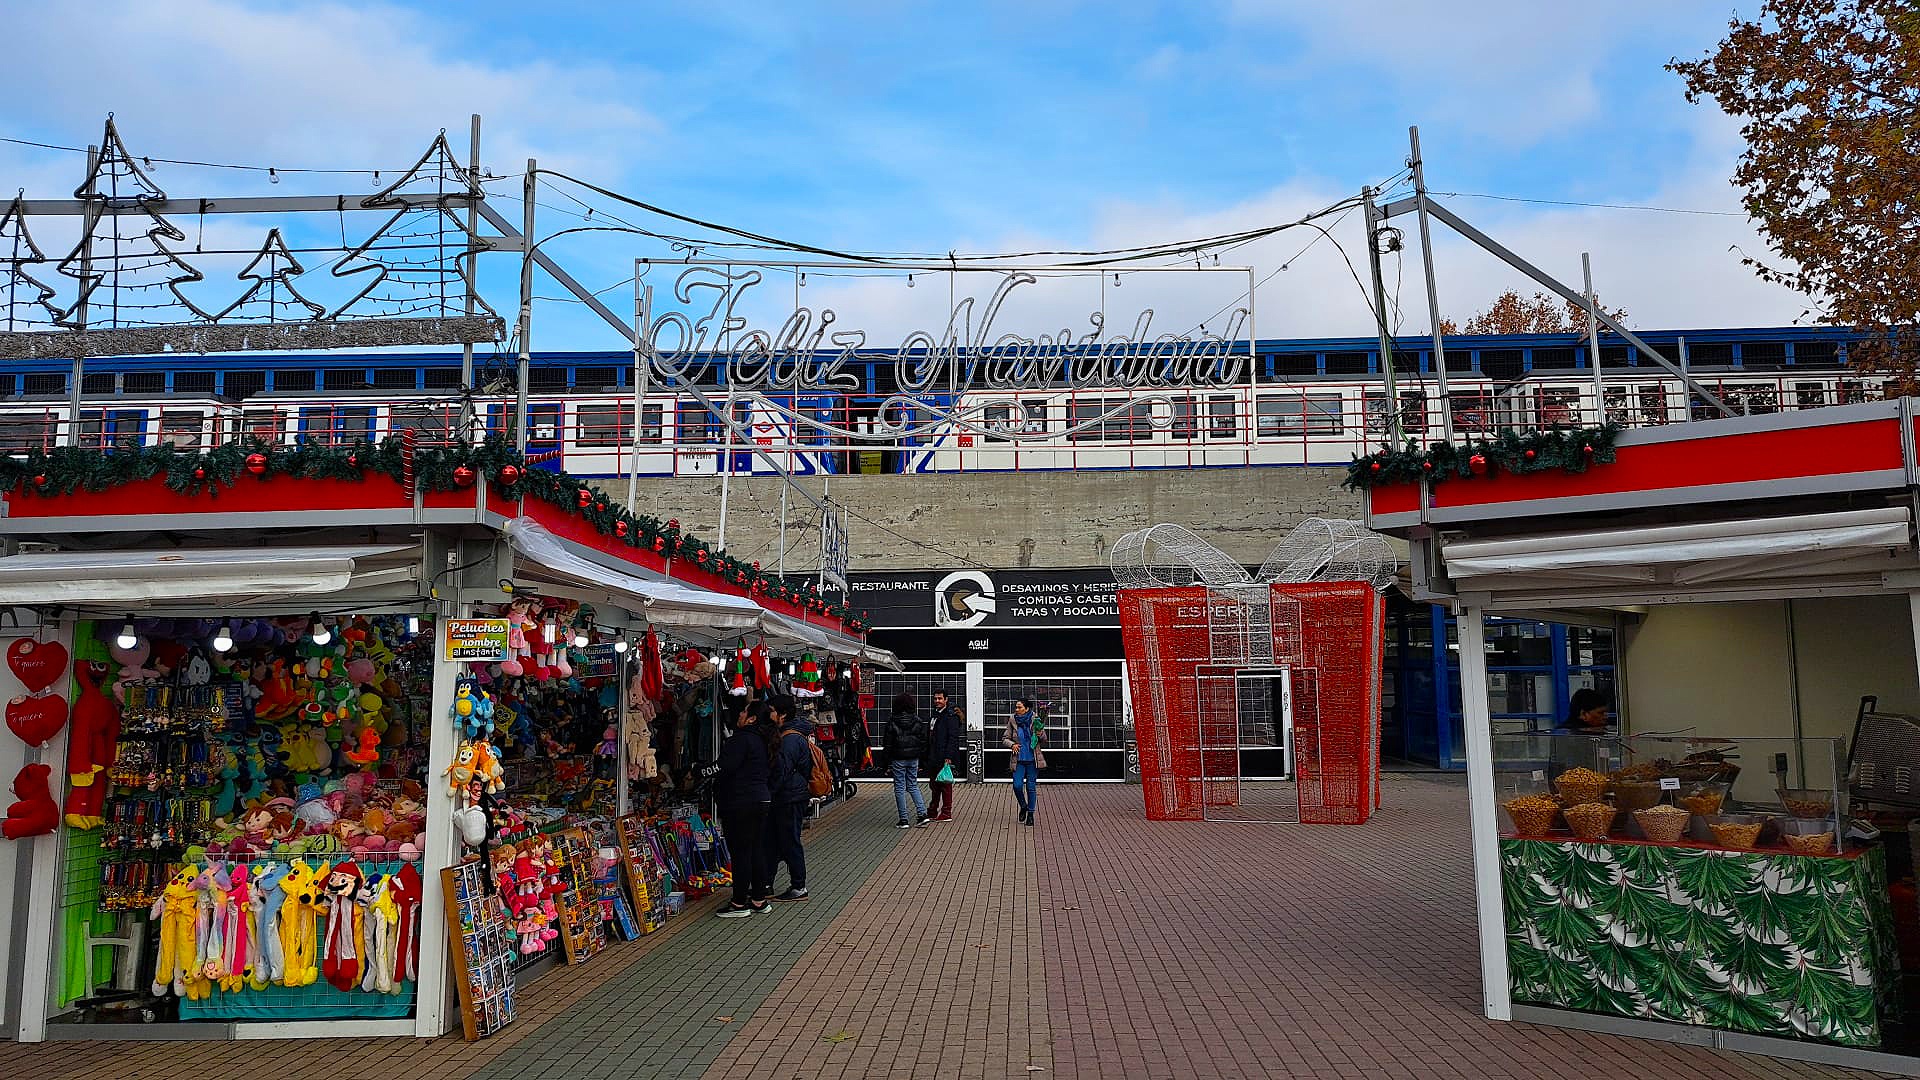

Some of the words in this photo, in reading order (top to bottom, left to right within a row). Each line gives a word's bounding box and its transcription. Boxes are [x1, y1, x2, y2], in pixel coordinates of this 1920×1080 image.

[648, 266, 866, 392] Feliz
[901, 272, 1248, 396] Navidad
[816, 583, 841, 592] BAR
[852, 581, 930, 591] RESTAURANTE
[1002, 583, 1070, 593] DESAYUNOS
[1072, 583, 1081, 592] Y
[1083, 582, 1119, 592] MERIE
[1018, 594, 1073, 605] COMIDAS
[1076, 594, 1121, 604] CASER
[1010, 607, 1048, 617] TAPAS
[1051, 607, 1060, 616] Y
[449, 622, 505, 633] Peluches
[461, 637, 501, 647] nombre
[453, 648, 460, 656] al
[463, 647, 501, 657] instante
[967, 740, 978, 775] AQUÍ
